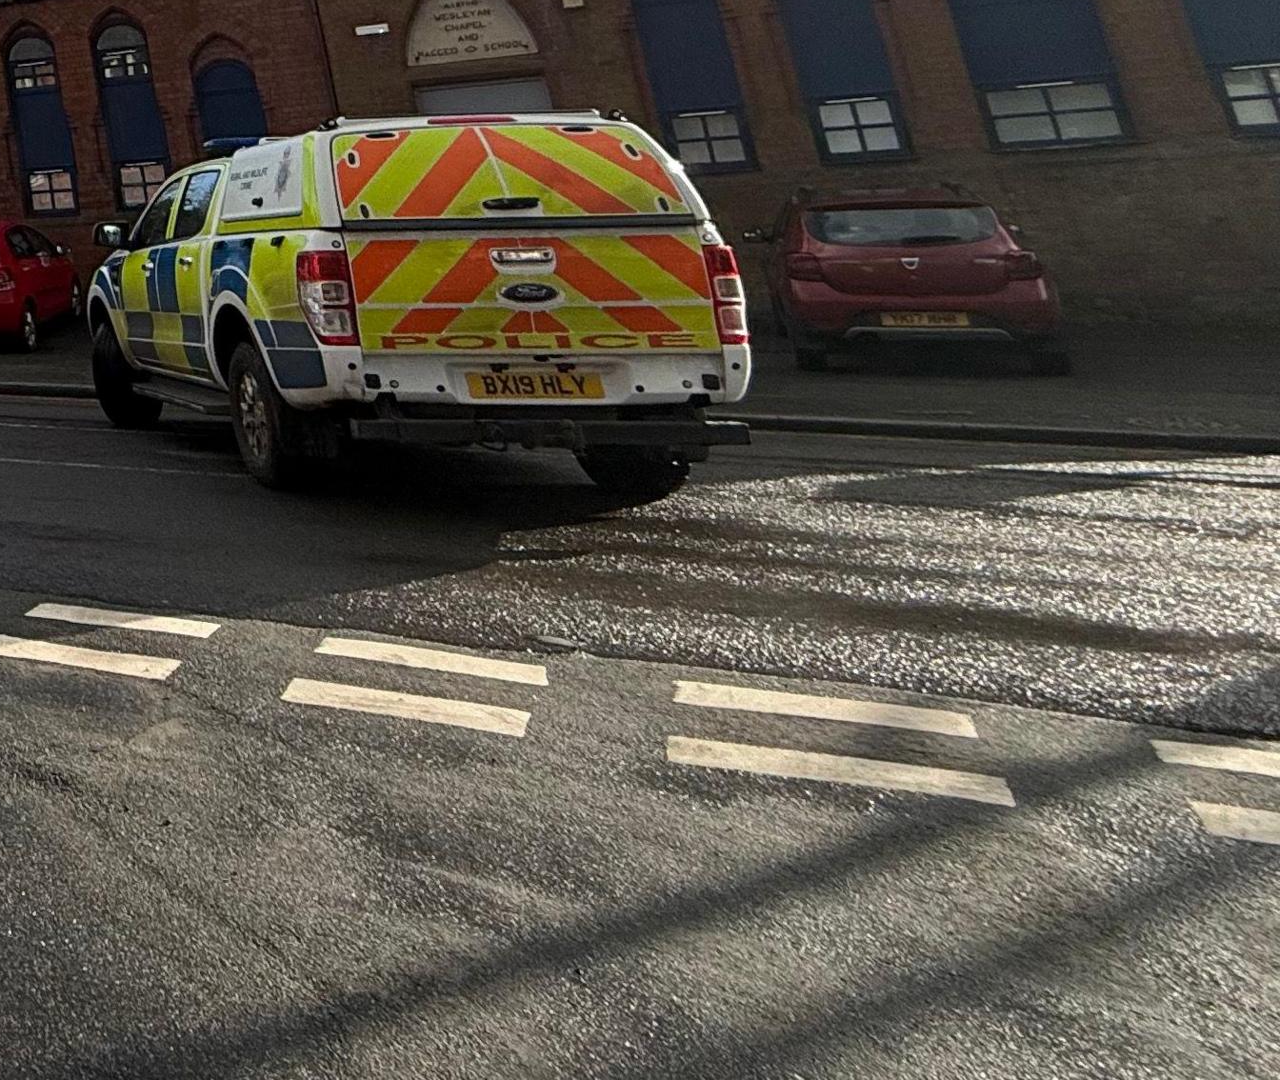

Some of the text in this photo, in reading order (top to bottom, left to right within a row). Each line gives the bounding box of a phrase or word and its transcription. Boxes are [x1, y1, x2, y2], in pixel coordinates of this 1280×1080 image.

[433, 9, 491, 21] WESLEYAN
[444, 21, 486, 32] CHAPEL
[483, 40, 523, 52] SCHOOL
[380, 333, 699, 350] POLICE
[481, 375, 586, 395] BX19 HLY
